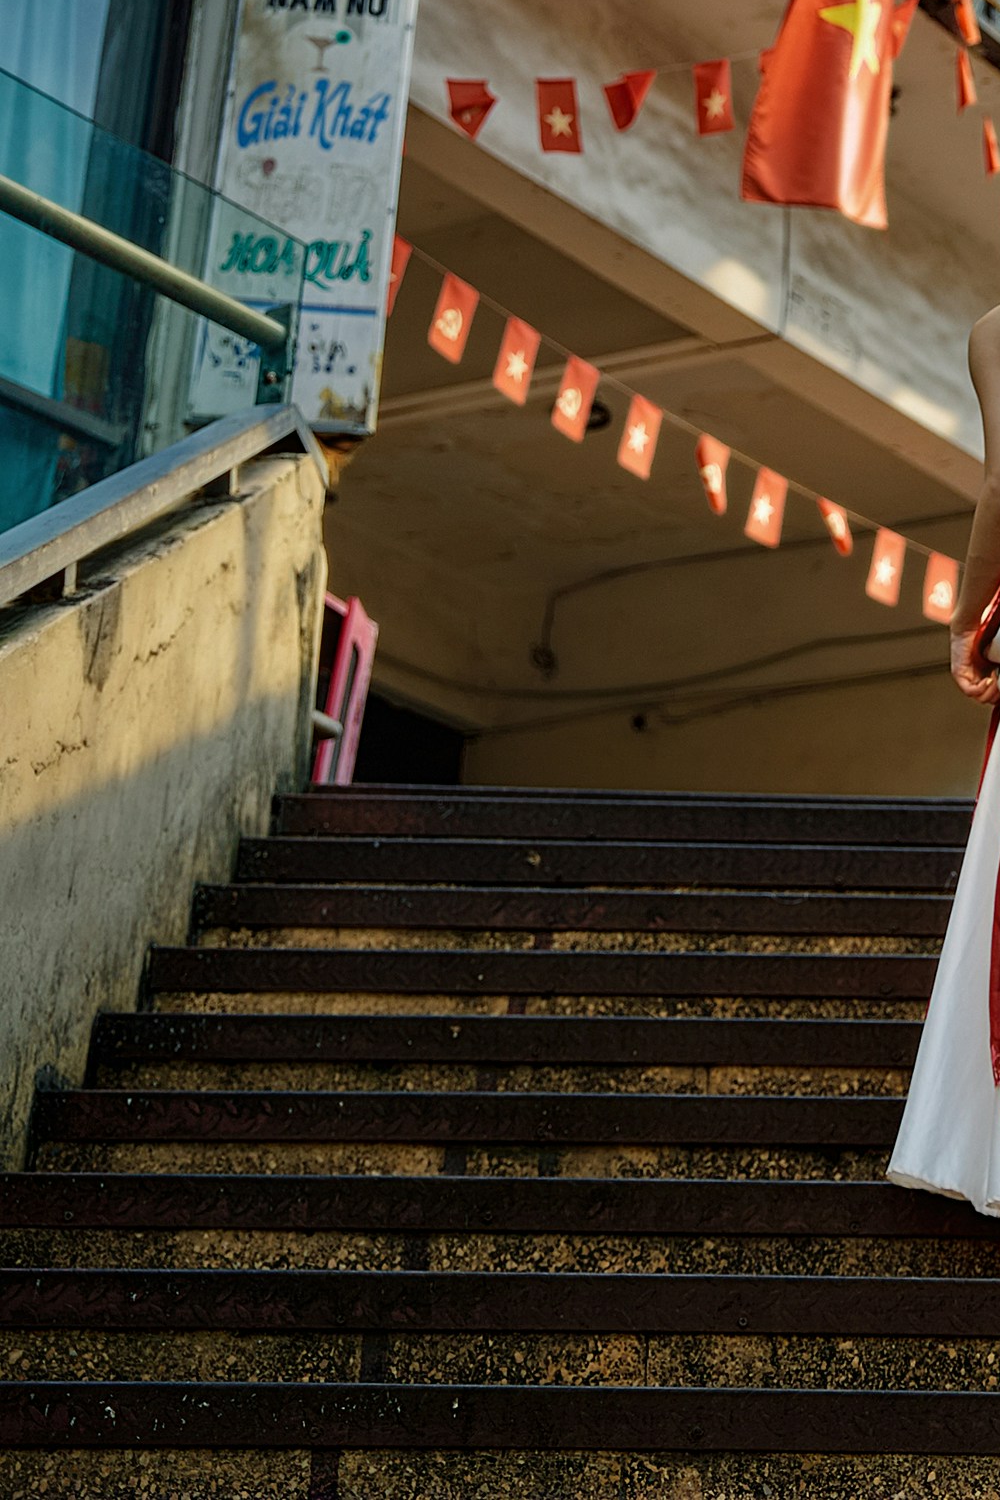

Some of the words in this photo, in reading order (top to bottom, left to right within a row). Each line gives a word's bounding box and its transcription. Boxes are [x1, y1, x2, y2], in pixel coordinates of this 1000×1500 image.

[237, 79, 308, 148] Giải
[310, 78, 391, 150] Khát
[221, 233, 295, 275] HOA
[304, 230, 371, 291] QUẢ
